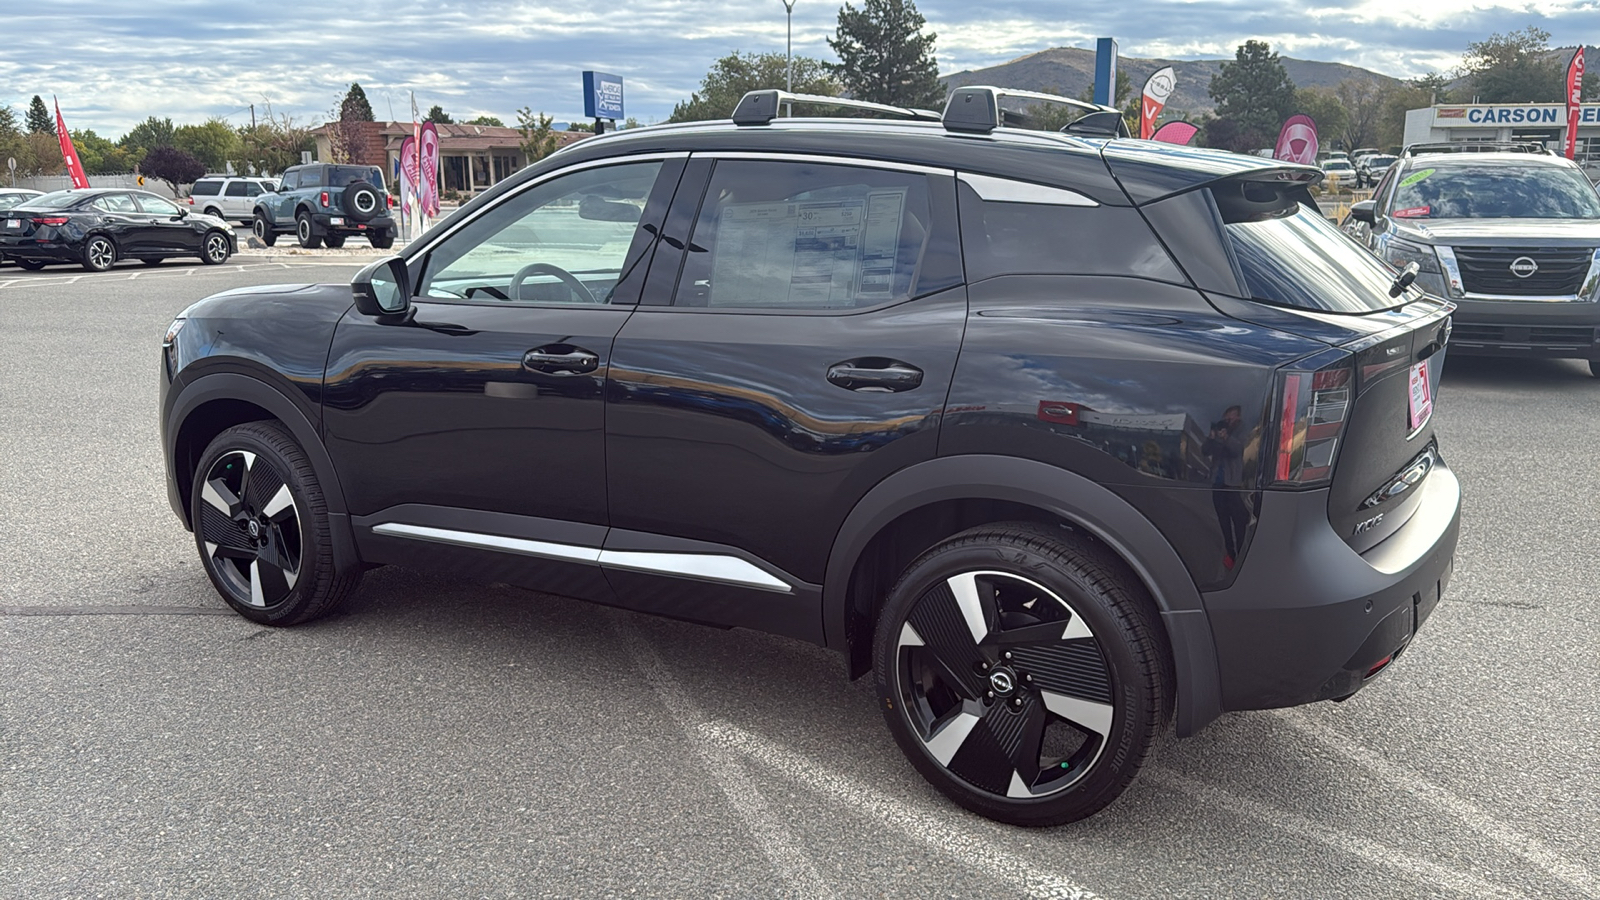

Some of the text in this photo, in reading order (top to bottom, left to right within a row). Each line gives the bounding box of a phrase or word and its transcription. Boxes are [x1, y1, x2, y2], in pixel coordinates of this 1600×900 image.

[1468, 108, 1557, 123] CARSON
[802, 211, 813, 221] 30
[1352, 512, 1384, 536] KICKS
[1109, 684, 1137, 775] BRIDGESTONE
